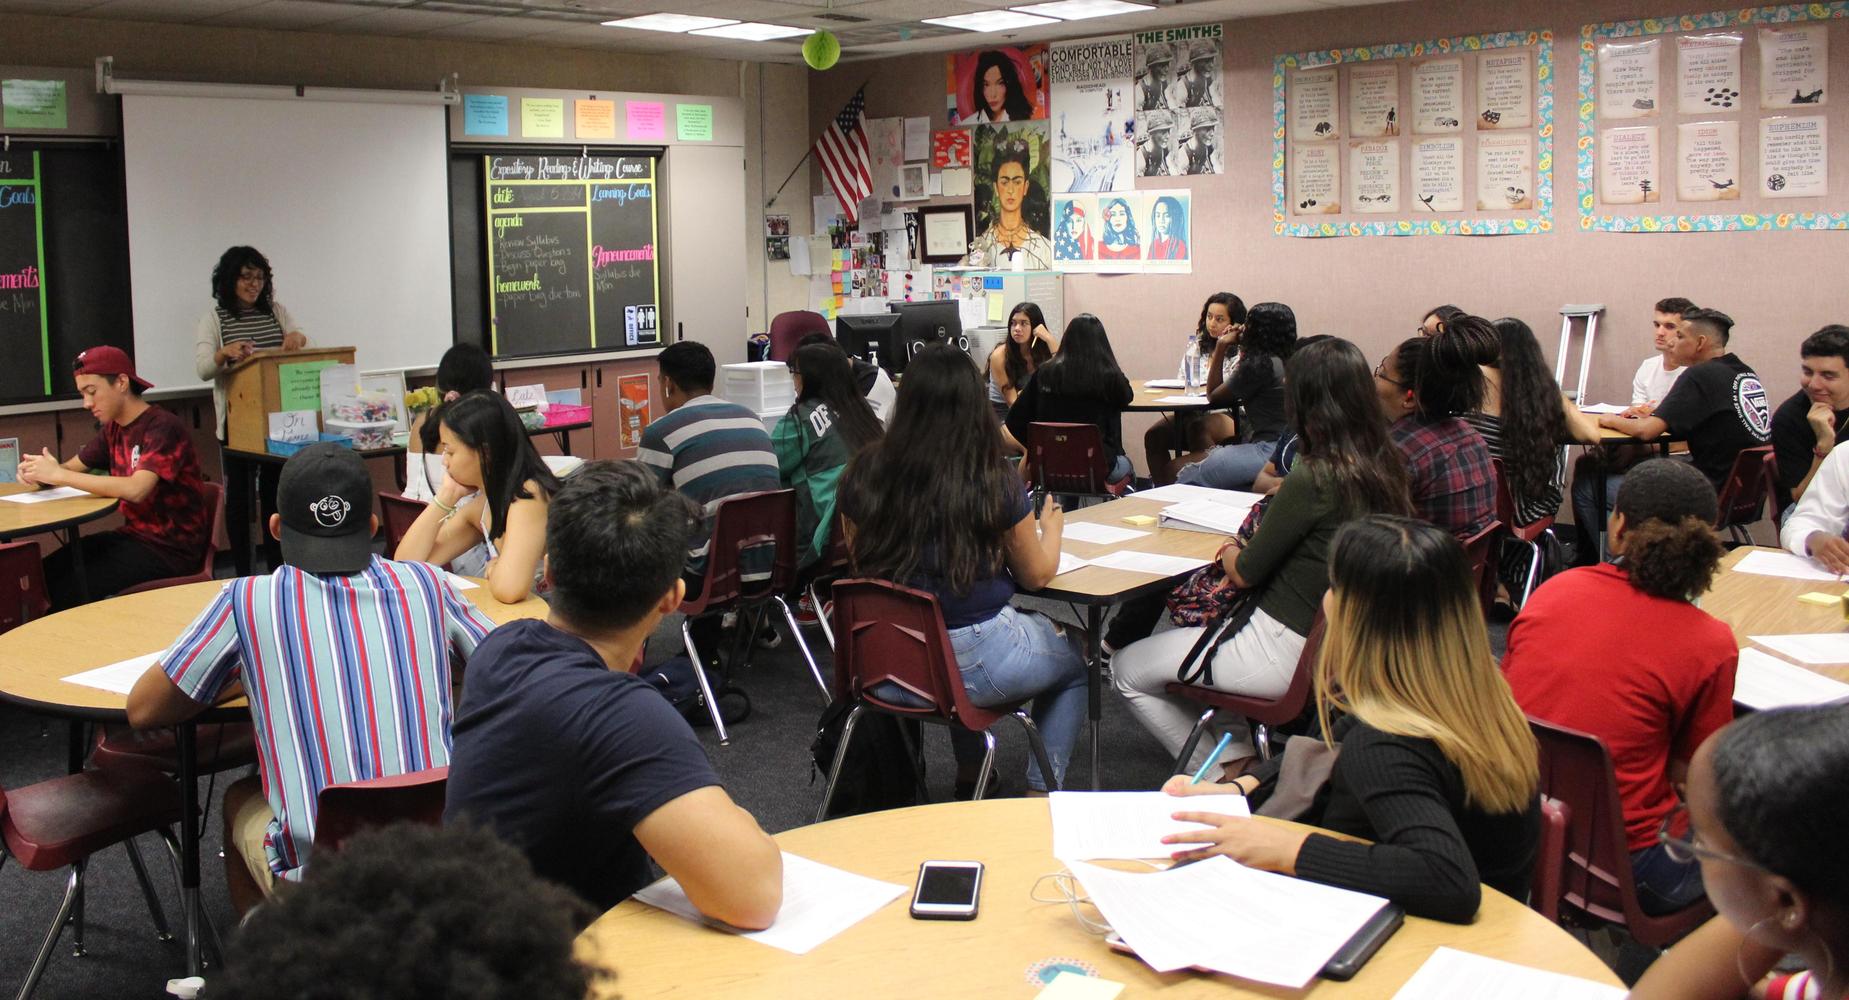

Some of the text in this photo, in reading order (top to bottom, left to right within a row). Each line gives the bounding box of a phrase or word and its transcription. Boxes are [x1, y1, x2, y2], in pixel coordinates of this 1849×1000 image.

[1136, 25, 1221, 44] THE SMITHS
[1051, 42, 1132, 63] COMFORTABLE
[1072, 63, 1085, 71] BUT
[1088, 61, 1101, 70] NOT
[1104, 60, 1111, 68] IN
[1113, 58, 1132, 67] LOVE
[491, 157, 534, 180] Expository
[537, 157, 571, 180] Reading
[579, 157, 614, 179] Writing
[616, 158, 643, 179] Course
[592, 184, 627, 207] Learning
[628, 184, 651, 200] Goals
[495, 213, 523, 238] agenda
[526, 234, 560, 251] Syllabus
[496, 273, 541, 293] homework
[594, 269, 627, 280] Syllabus
